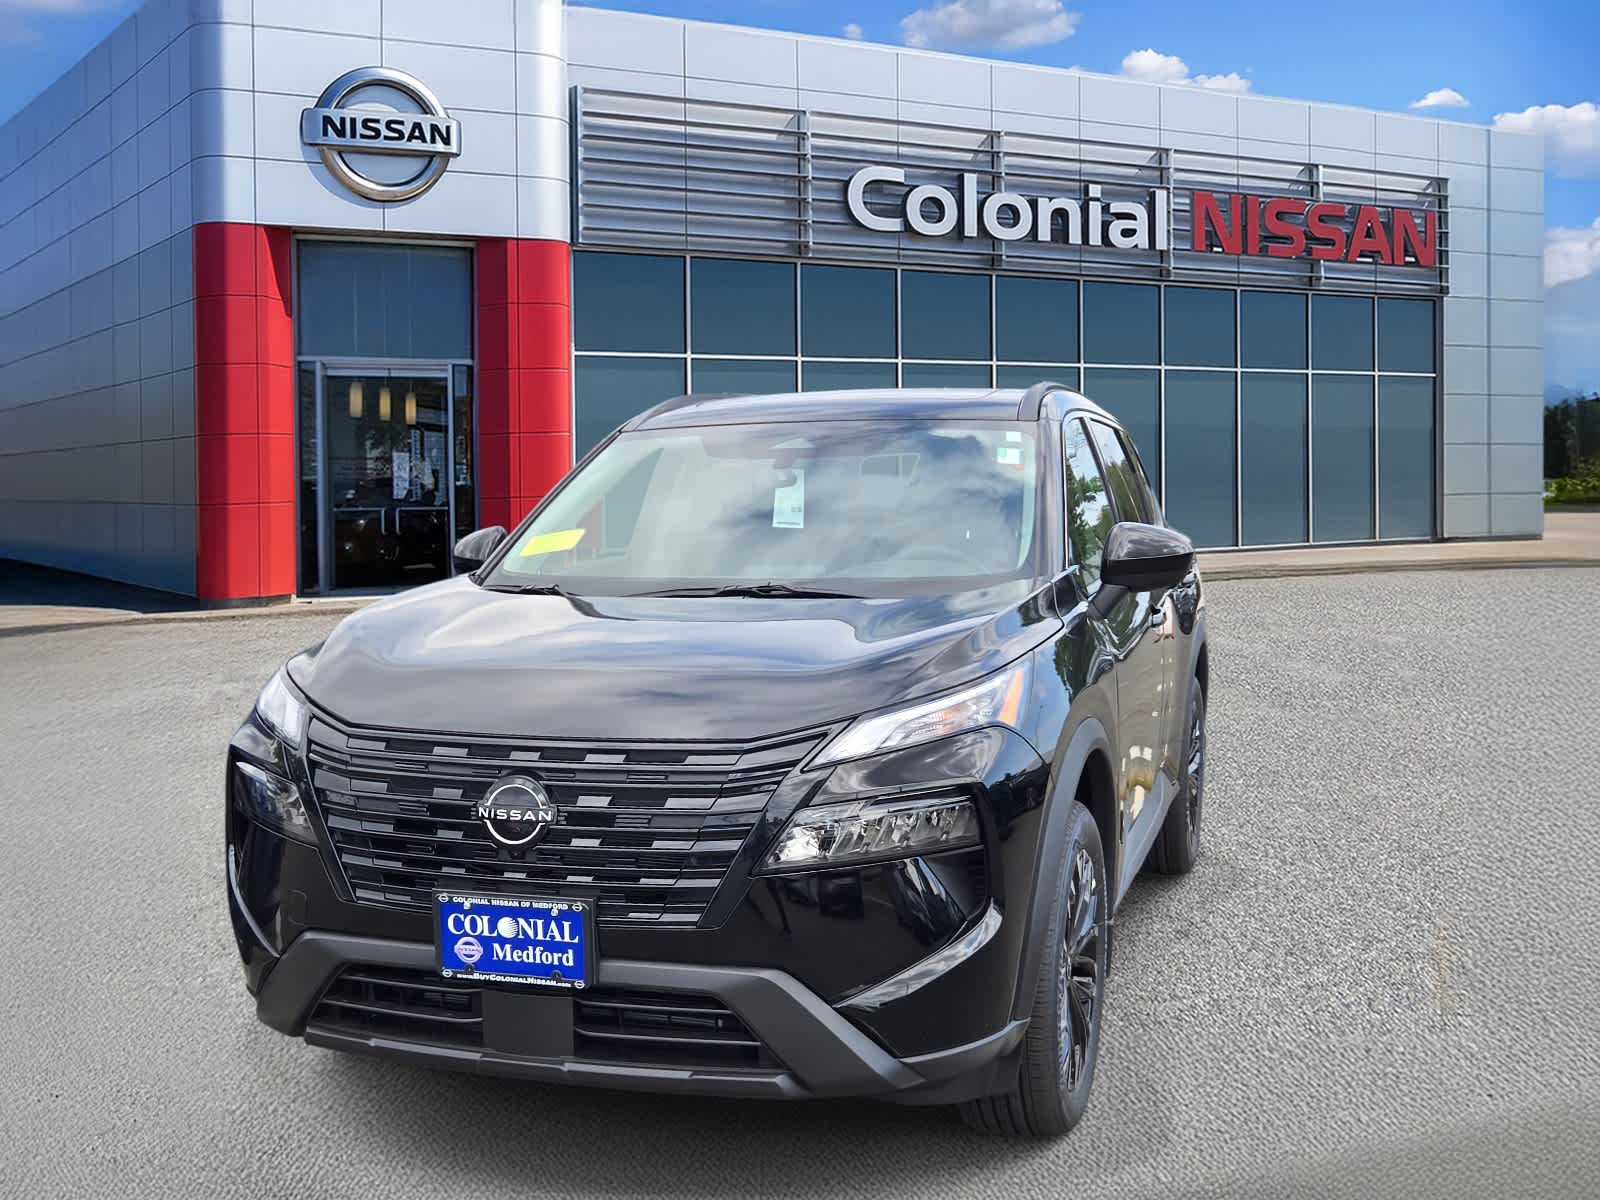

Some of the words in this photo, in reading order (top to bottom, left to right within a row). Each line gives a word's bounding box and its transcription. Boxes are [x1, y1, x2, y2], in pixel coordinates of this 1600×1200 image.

[322, 115, 452, 147] NISSAN
[847, 166, 1168, 250] Colonial
[1191, 190, 1436, 267] NISSAN
[478, 806, 552, 822] NISSAN
[452, 896, 490, 905] COLONIAL
[532, 902, 569, 910] MEDFORD
[447, 913, 579, 943] COLONIAL
[493, 943, 574, 966] Medford
